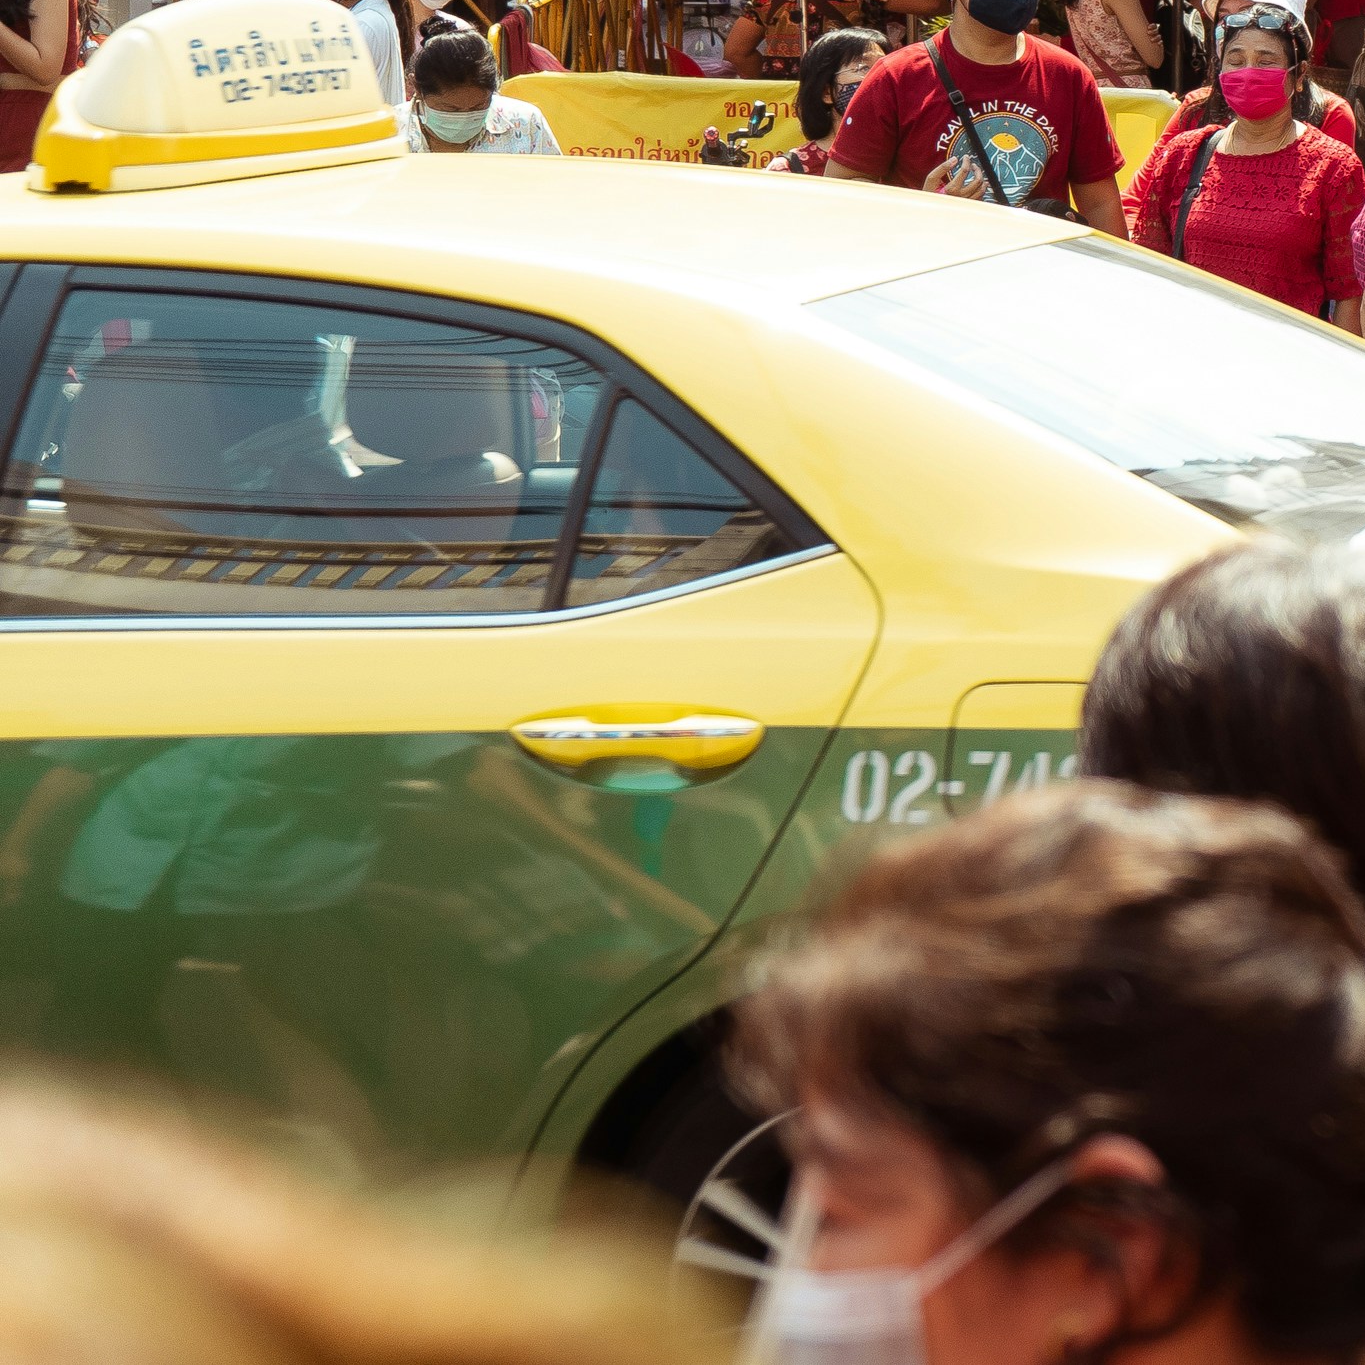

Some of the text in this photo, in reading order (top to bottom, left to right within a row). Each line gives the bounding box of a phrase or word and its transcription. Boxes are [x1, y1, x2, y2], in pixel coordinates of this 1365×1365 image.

[936, 99, 1060, 155] TRAVL IN THE DARK
